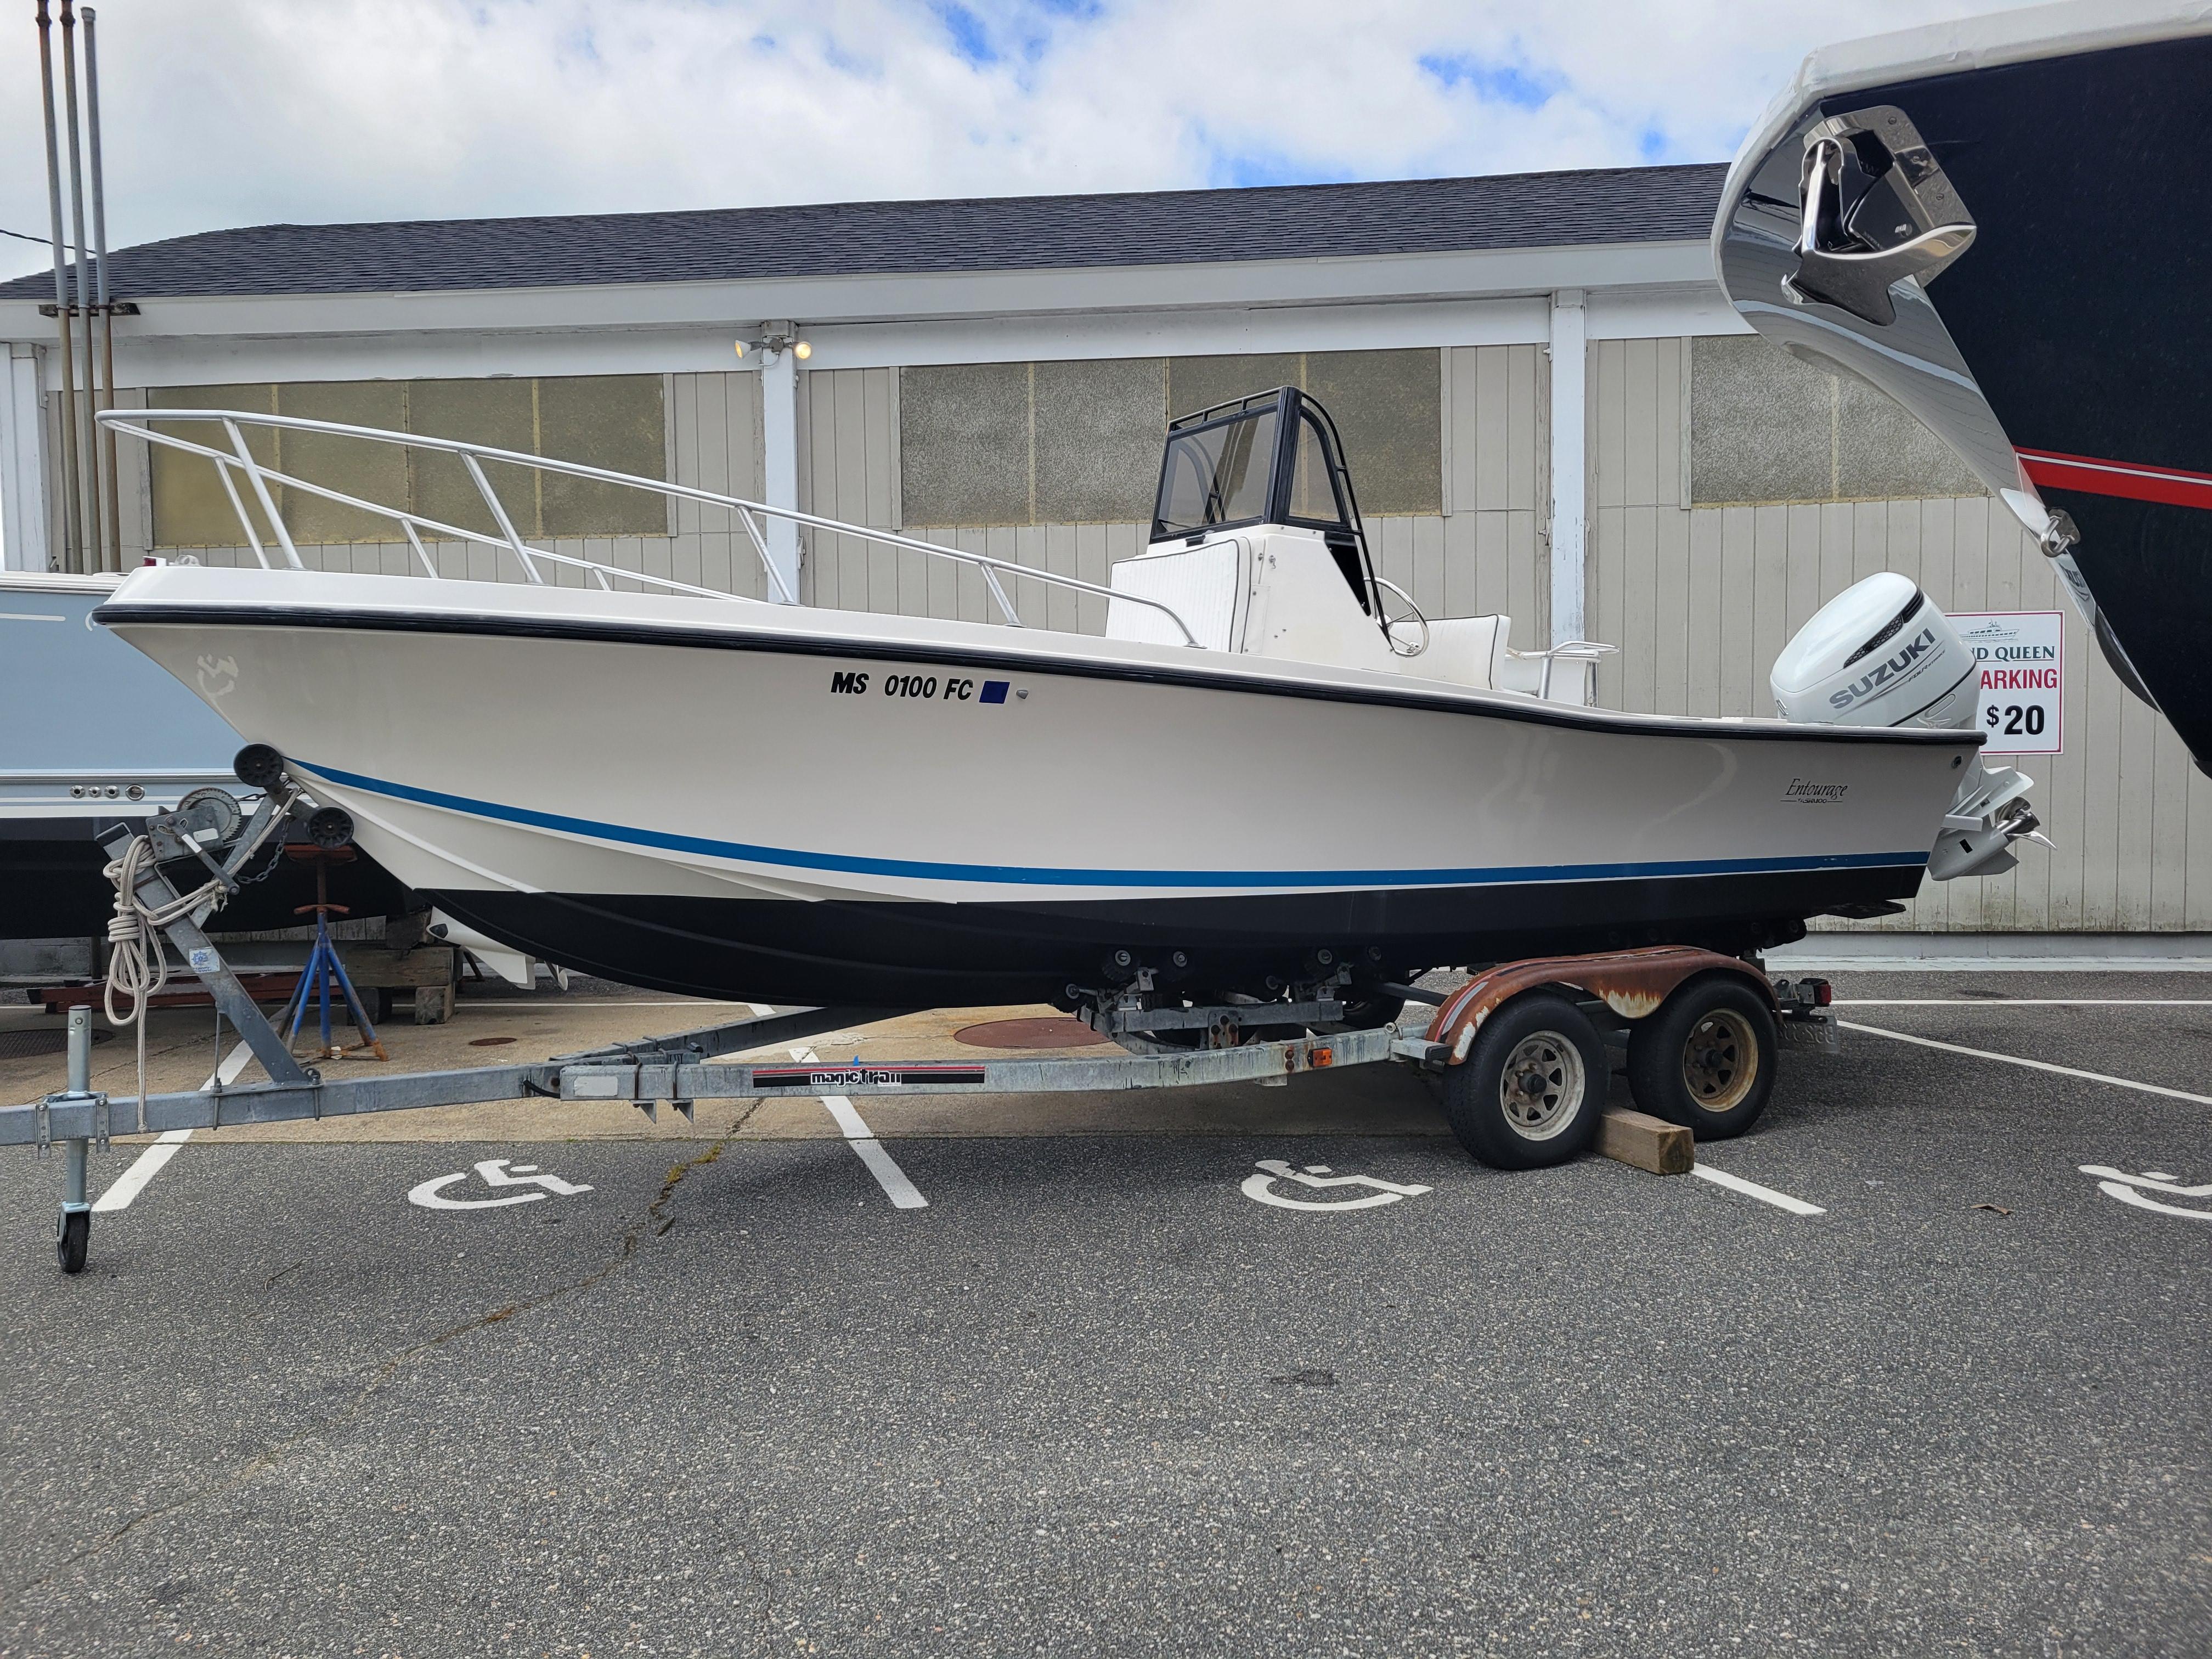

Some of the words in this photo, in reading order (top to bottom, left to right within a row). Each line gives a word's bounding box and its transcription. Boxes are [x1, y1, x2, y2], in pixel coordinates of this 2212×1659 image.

[1995, 646, 2055, 662] QUEEN
[1829, 628, 1936, 709] SUZUKI
[1980, 668, 2057, 690] ARKING
[831, 672, 869, 694] MS
[885, 675, 937, 698] 0100
[944, 678, 974, 700] FC
[1785, 778, 1848, 800] Entourage
[811, 1069, 901, 1087] magictrail
